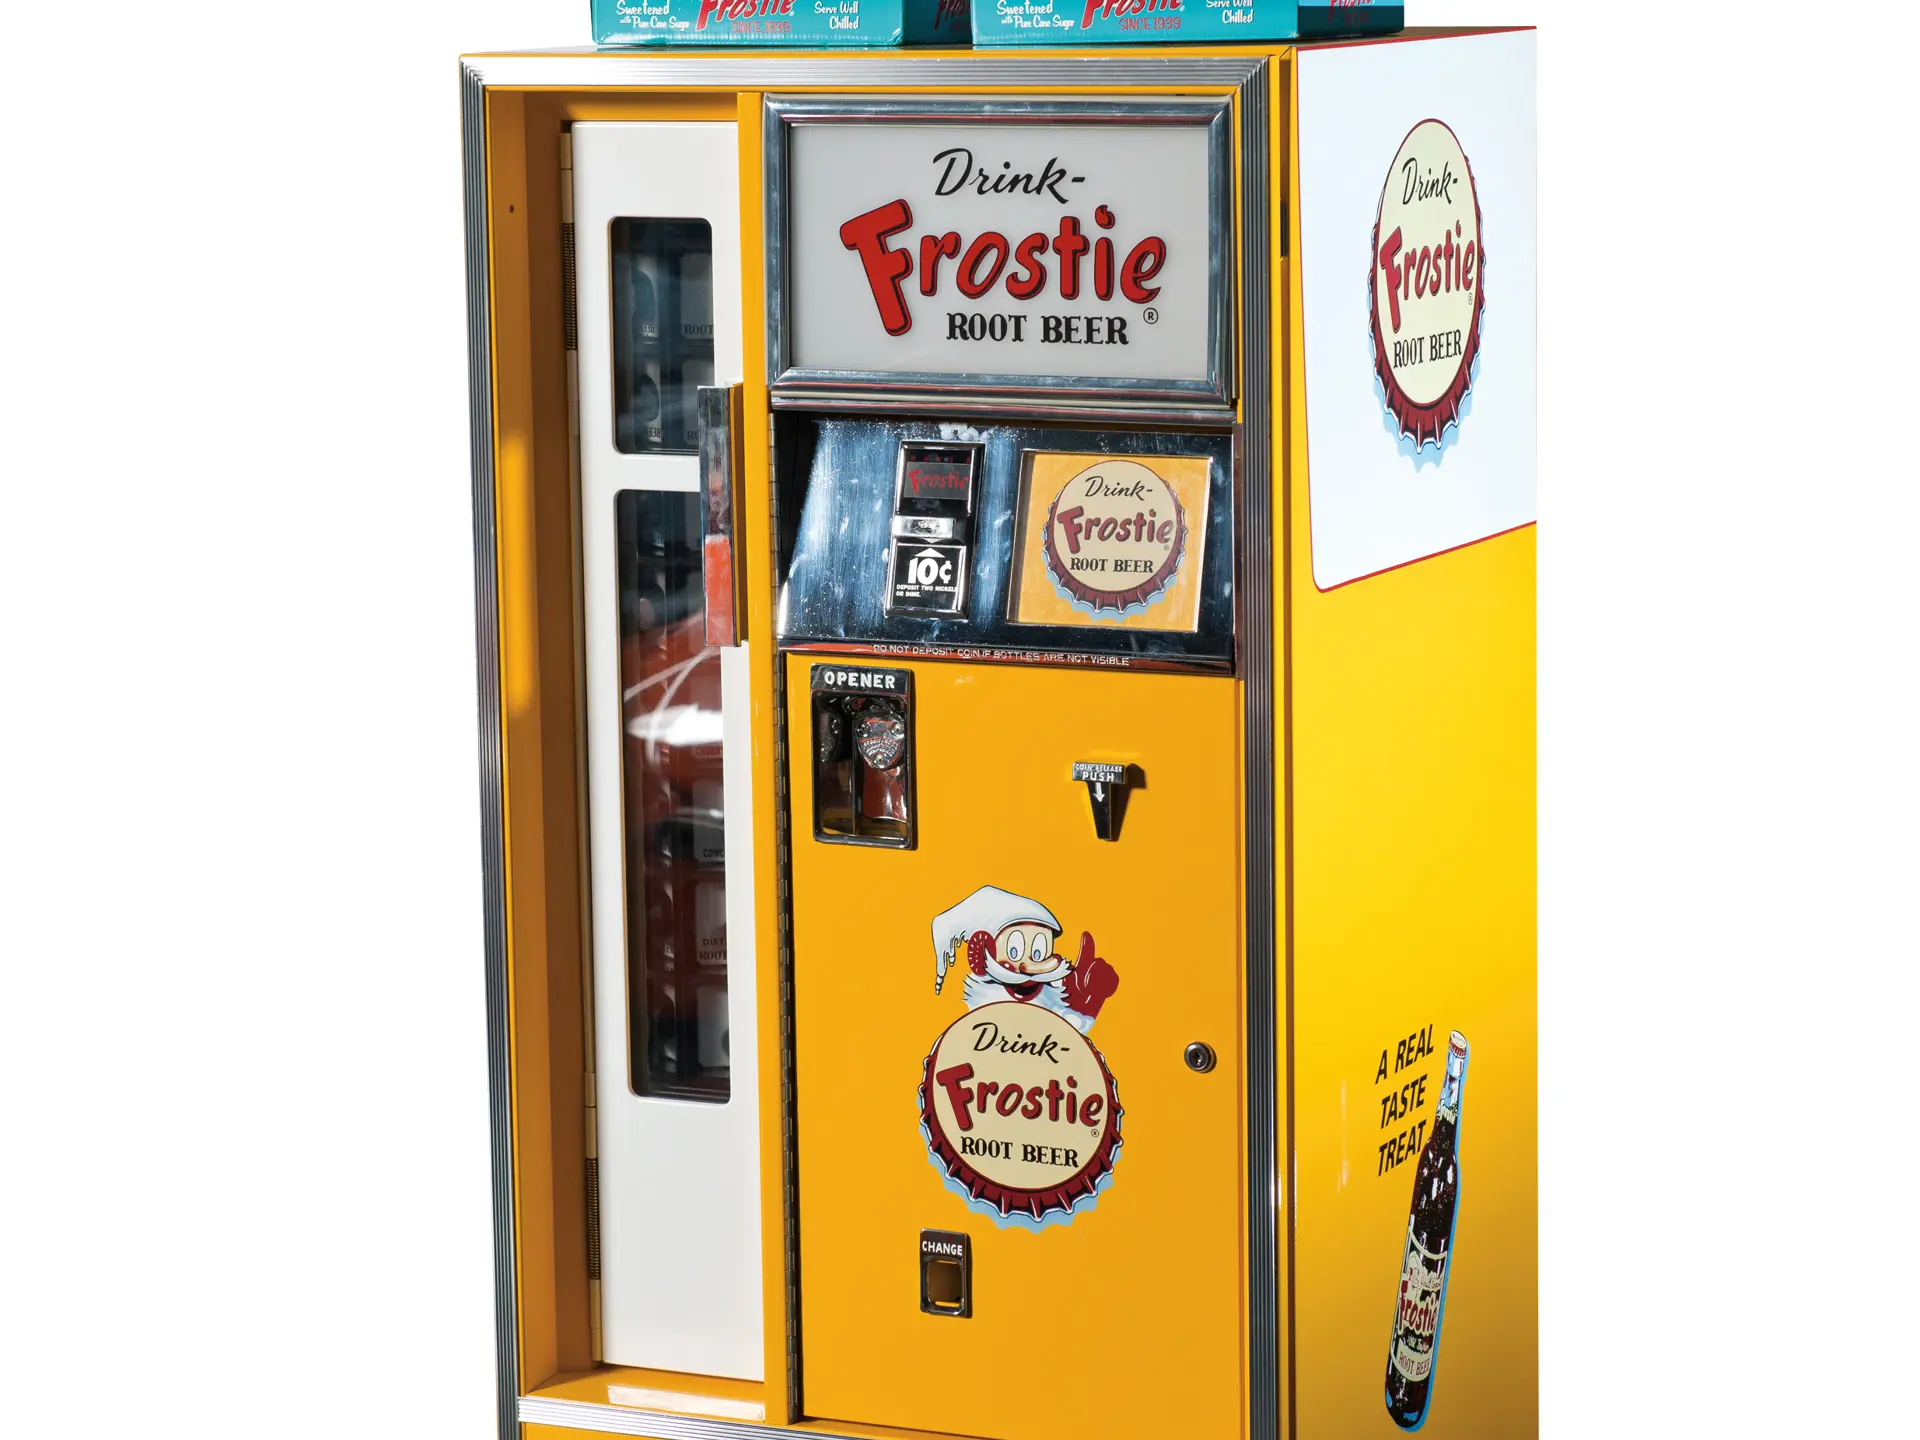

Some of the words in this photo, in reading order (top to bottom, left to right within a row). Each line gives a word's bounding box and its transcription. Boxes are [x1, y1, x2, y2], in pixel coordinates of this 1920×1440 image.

[616, 0, 670, 15] Sweetened
[814, 1, 838, 14] Serve
[840, 1, 859, 14] Well
[996, 0, 1053, 15] Sweetened
[1206, 0, 1231, 8] Serve
[632, 16, 649, 29] Pure
[650, 16, 668, 28] Cane
[668, 16, 690, 31] Sugar
[731, 21, 762, 34] SINCE
[764, 21, 791, 33] 1939
[829, 15, 859, 30] Chilled
[1013, 15, 1032, 28] Pure
[1033, 15, 1051, 28] Cane
[1052, 15, 1075, 30] Sugar
[1118, 17, 1151, 31] SINCE
[1153, 16, 1182, 30] 1939
[1222, 9, 1254, 24] Chilled
[932, 147, 1087, 205] Drink-
[1402, 157, 1459, 206] Drink-
[838, 198, 1168, 338] Frostie
[1379, 219, 1475, 334] Frostie
[684, 325, 714, 335] ROOT
[946, 312, 1027, 342] ROOT
[1040, 315, 1130, 346] BEER
[1393, 336, 1425, 369] ROOT
[1429, 328, 1463, 362] BEER
[908, 469, 969, 495] Frostie
[1085, 475, 1153, 501] Drink-
[1056, 505, 1174, 554] Frostie
[907, 557, 953, 586] 10¢
[1069, 557, 1108, 572] ROOT
[1113, 559, 1154, 574] BEER
[873, 644, 888, 653] DO
[889, 646, 909, 654] NOT
[912, 647, 953, 656] DEPOSIT
[957, 648, 980, 659] COIN
[982, 650, 991, 658] IF
[993, 650, 1040, 661] BOTTLES
[1043, 653, 1064, 663] ARE
[1067, 654, 1088, 663] NOT
[1090, 655, 1130, 666] VISIBLE
[824, 671, 896, 689] OPENER
[1075, 763, 1093, 771] COIN
[1082, 771, 1115, 782] PUSH
[703, 849, 724, 858] CONC
[972, 1022, 1070, 1064] Drink-
[1375, 1049, 1388, 1085] A
[1394, 1023, 1434, 1074] REAL
[936, 1062, 1104, 1132] Frostie
[1380, 1073, 1428, 1130] TASTE
[960, 1136, 1013, 1160] ROOT
[1021, 1143, 1079, 1168] BEER
[1378, 1119, 1427, 1177] TREAT
[921, 1240, 963, 1256] CHANGE
[1399, 1351, 1415, 1375] ROOT
